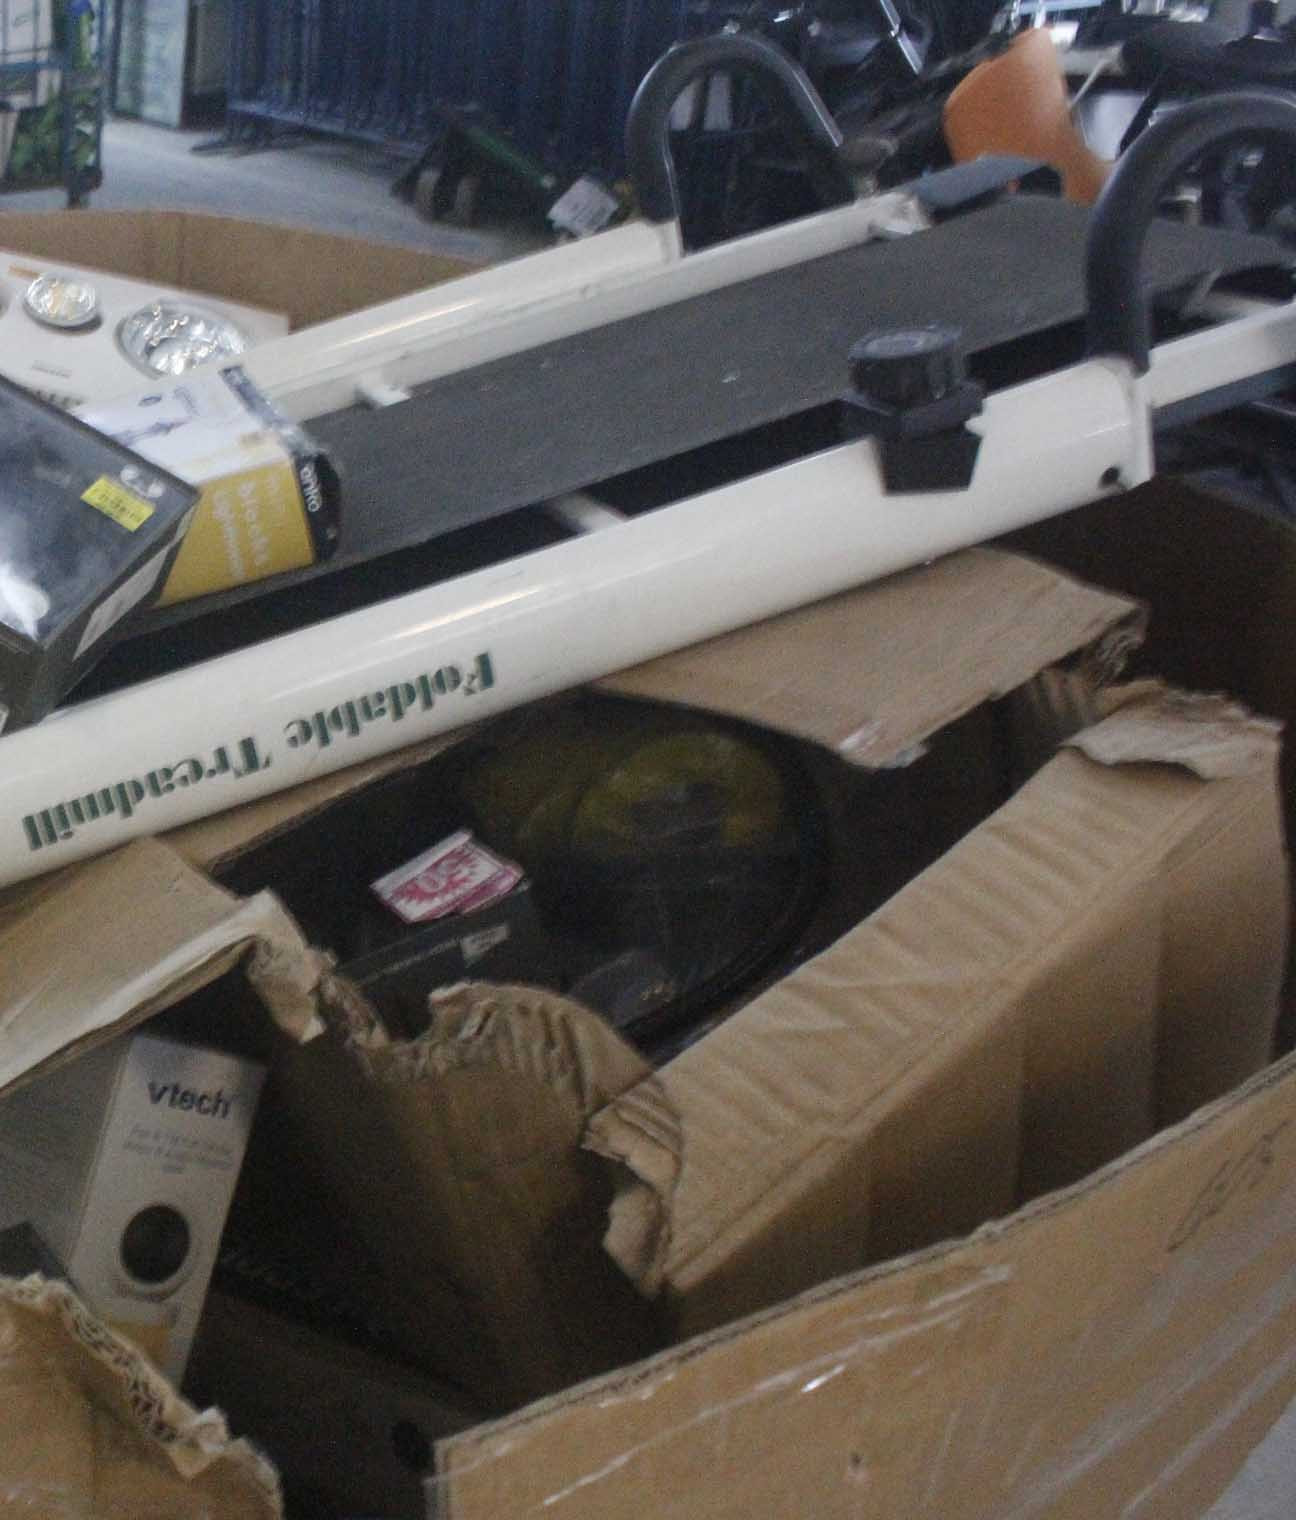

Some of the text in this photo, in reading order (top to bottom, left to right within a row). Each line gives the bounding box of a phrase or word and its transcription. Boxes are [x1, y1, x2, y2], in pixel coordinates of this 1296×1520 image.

[299, 463, 322, 513] anko
[20, 651, 497, 851] Foldable Treadmill
[148, 1079, 231, 1120] vtech
